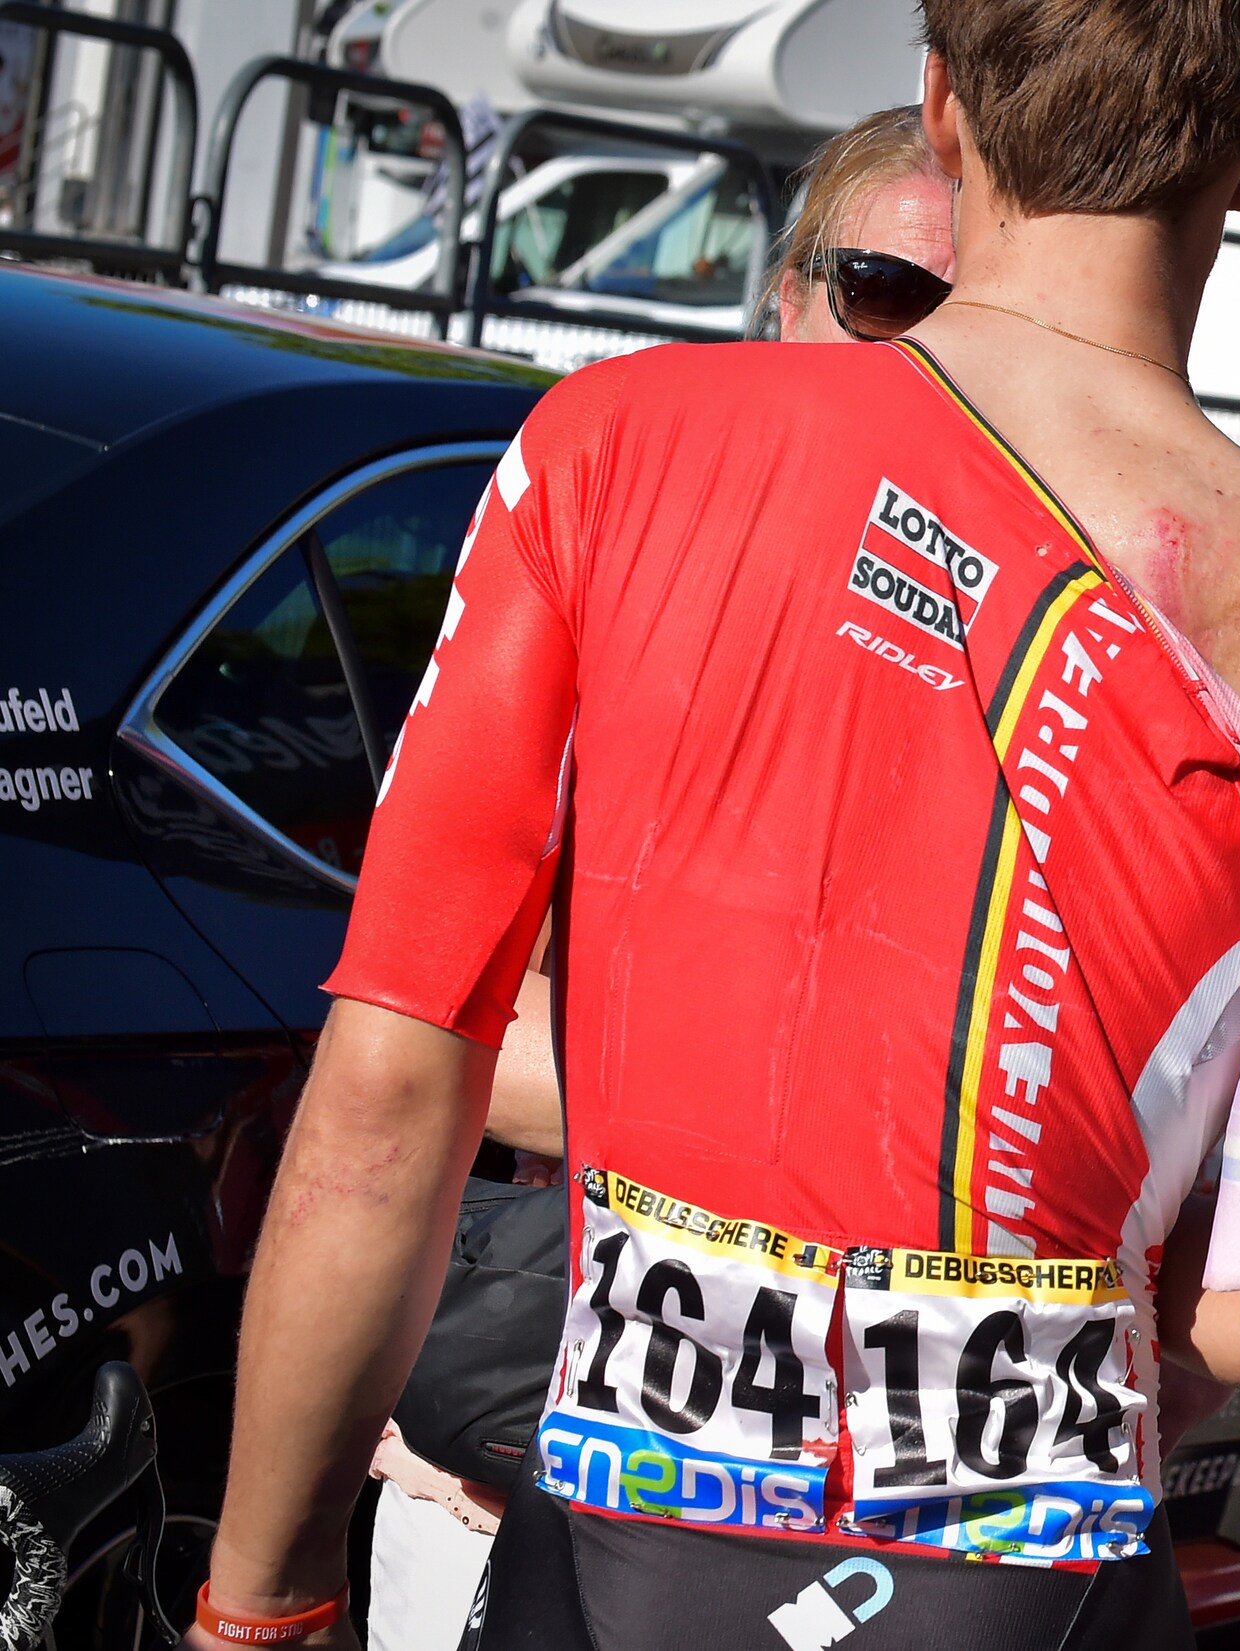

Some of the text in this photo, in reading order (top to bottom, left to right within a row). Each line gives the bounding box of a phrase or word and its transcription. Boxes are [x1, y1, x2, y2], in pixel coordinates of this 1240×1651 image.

[878, 488, 984, 588] LOTTO
[852, 555, 965, 644] SOUDA
[835, 620, 966, 691] RIDLEY
[615, 1176, 789, 1261] DEBUSSCHERE
[576, 1230, 821, 1462] 164
[863, 1309, 1129, 1489] 164
[217, 1620, 252, 1640] FIGHT
[254, 1626, 278, 1641] FOR
